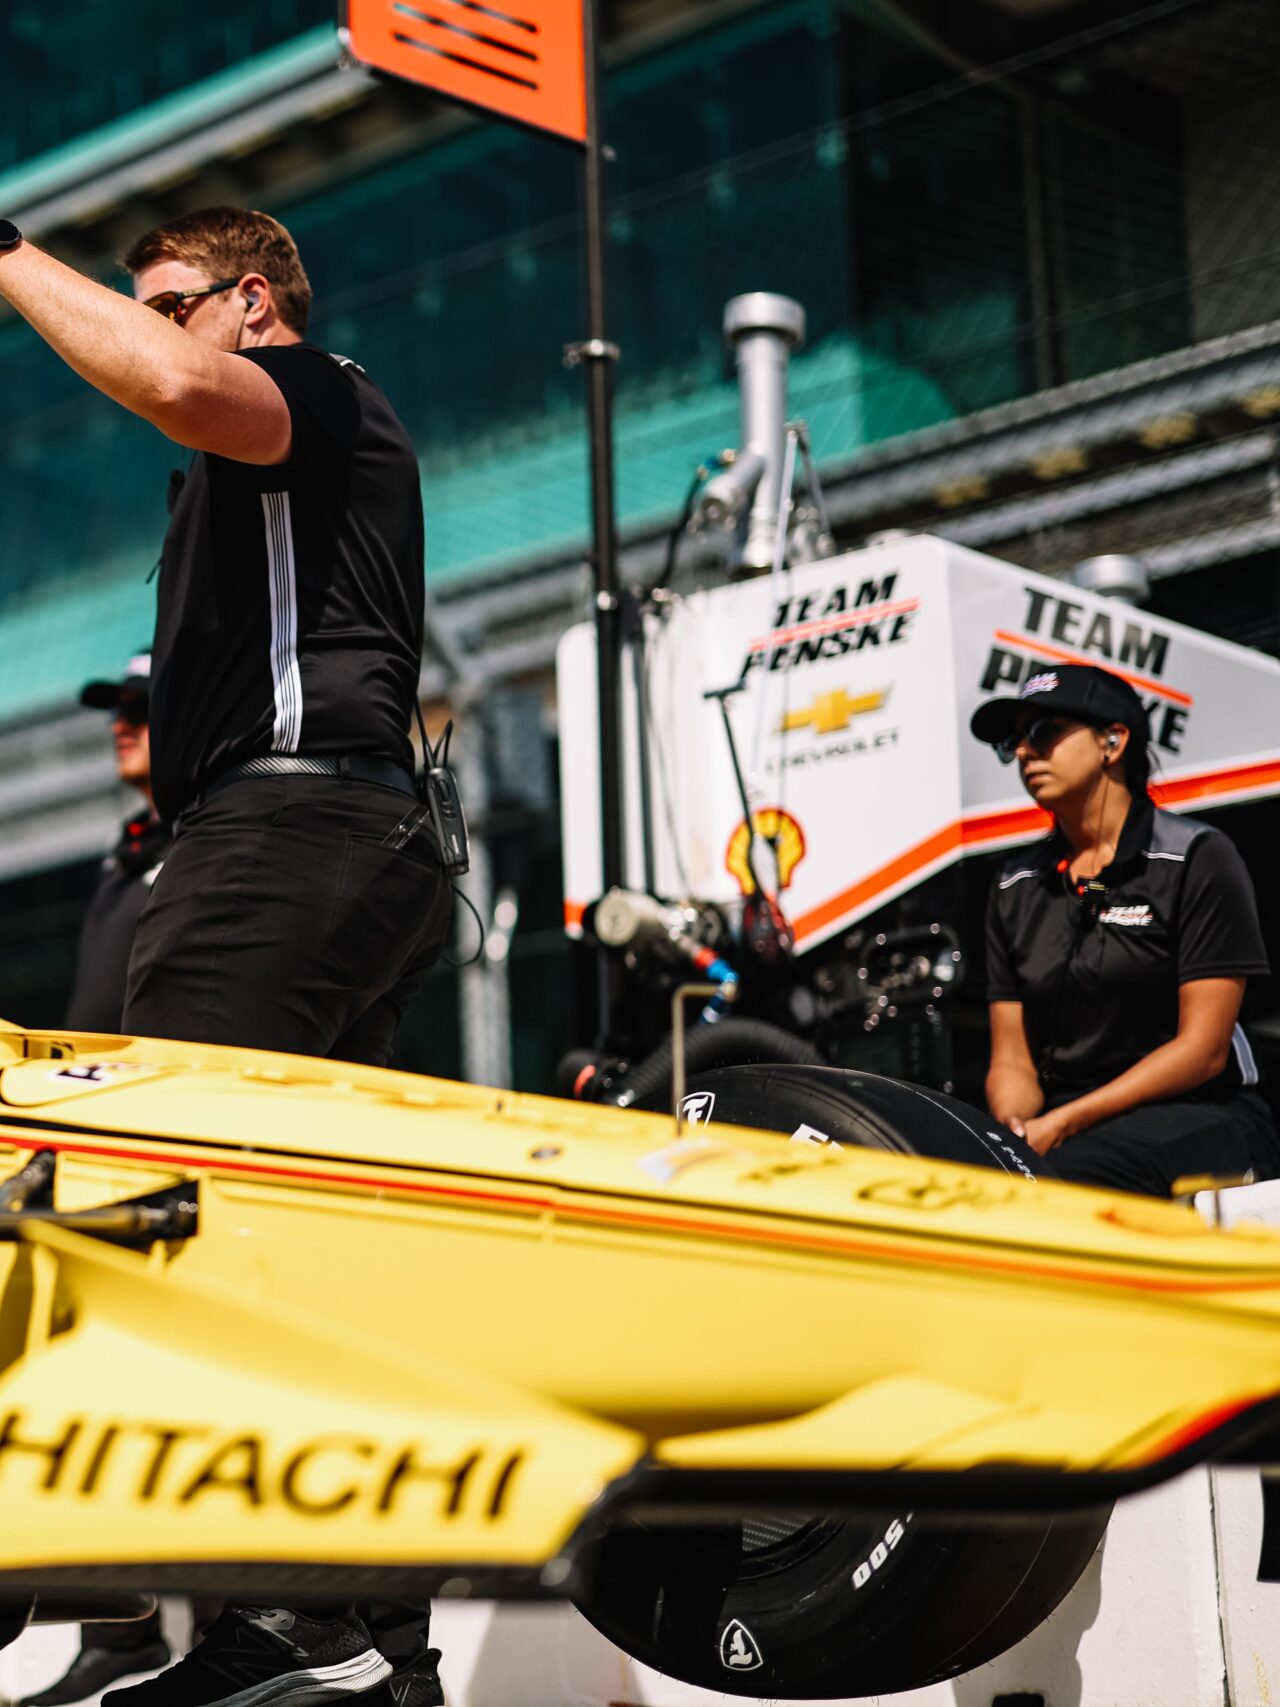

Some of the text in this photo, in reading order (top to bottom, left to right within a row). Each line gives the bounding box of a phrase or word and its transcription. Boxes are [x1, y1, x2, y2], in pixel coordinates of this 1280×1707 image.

[774, 573, 898, 628] TEAM
[1024, 586, 1171, 676] TEAM
[740, 613, 912, 681] PENSKE
